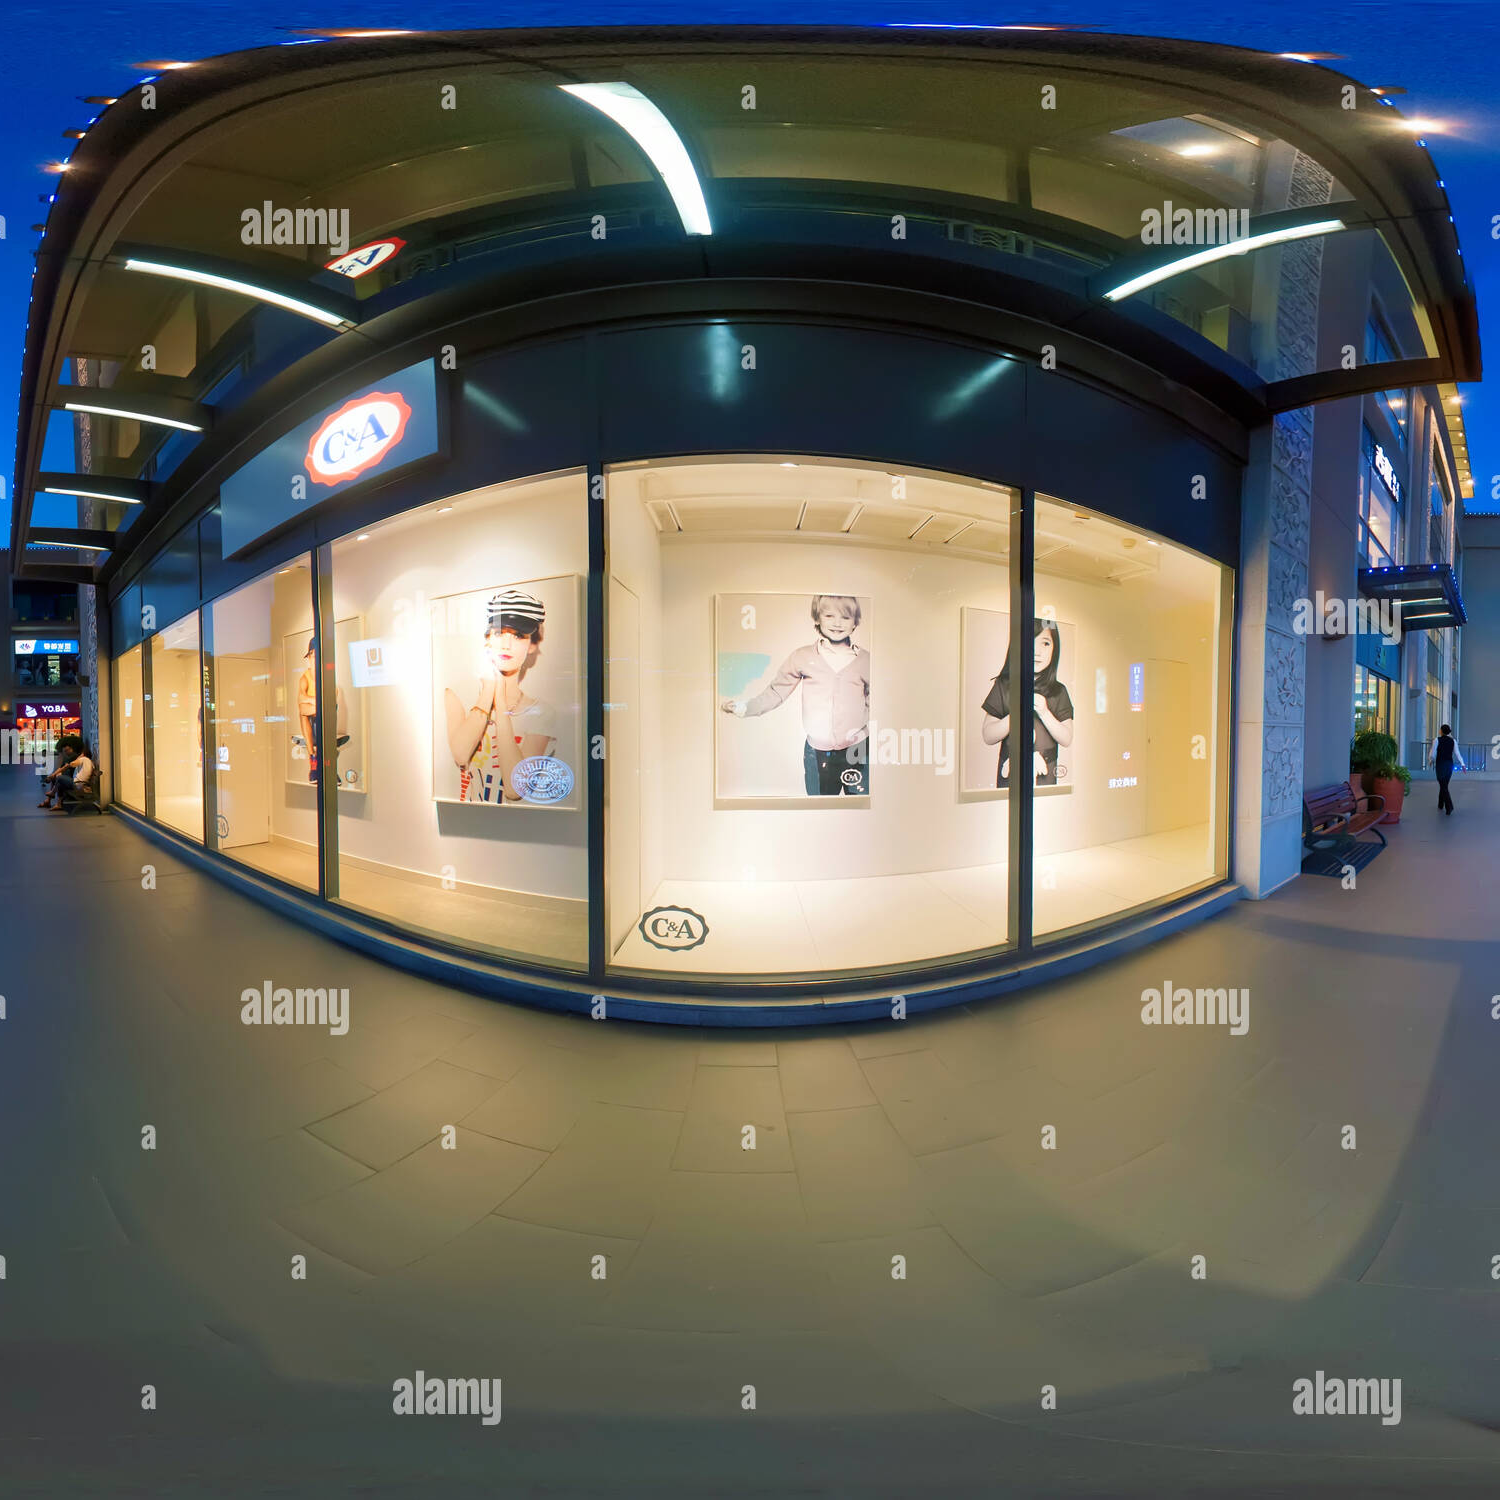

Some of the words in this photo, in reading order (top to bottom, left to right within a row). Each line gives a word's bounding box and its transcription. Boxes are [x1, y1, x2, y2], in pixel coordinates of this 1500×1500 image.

[323, 413, 389, 464] C&A
[42, 705, 68, 713] YO.BA.
[651, 917, 697, 939] C&A
